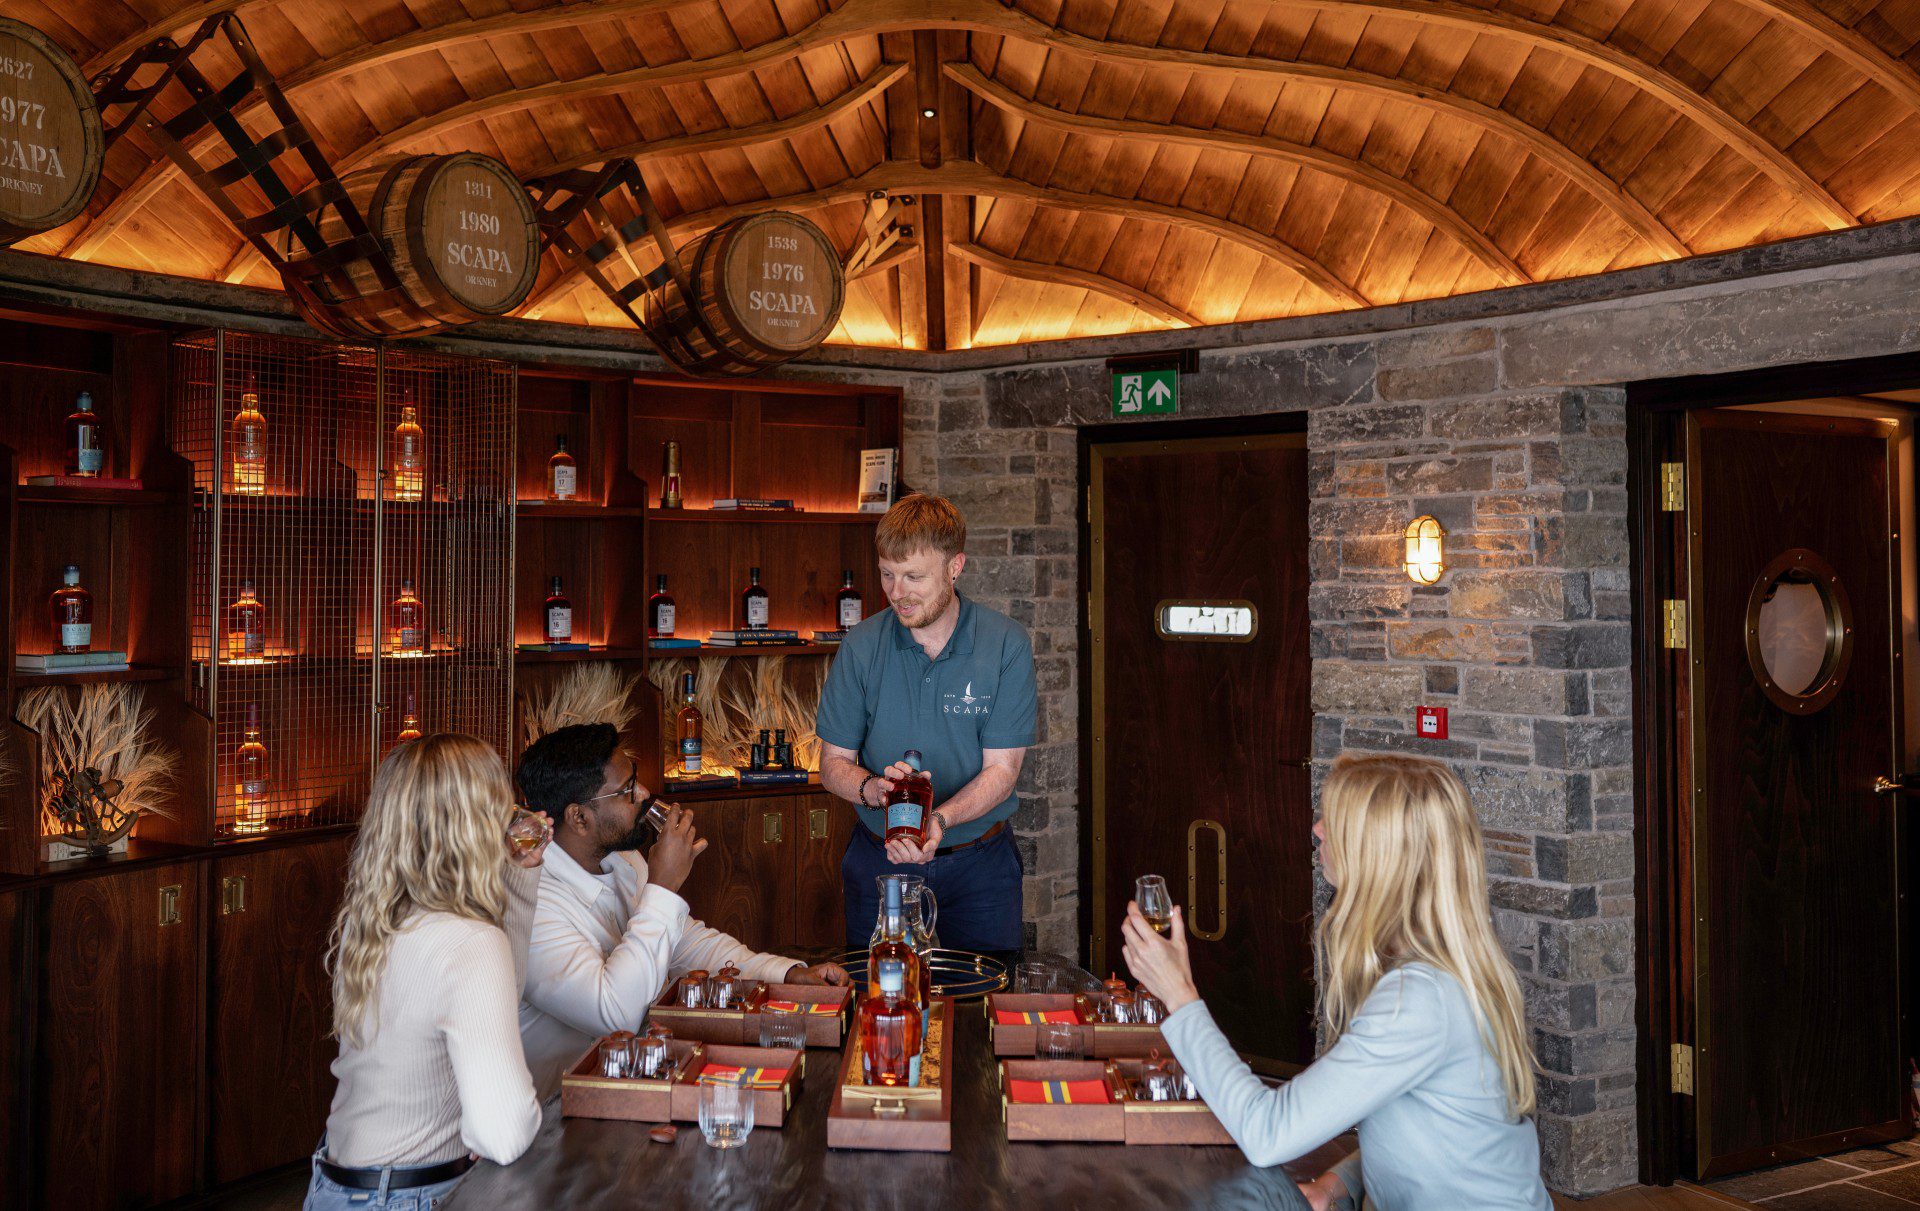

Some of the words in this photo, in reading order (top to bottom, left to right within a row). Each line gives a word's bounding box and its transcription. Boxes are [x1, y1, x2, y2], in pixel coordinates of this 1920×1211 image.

[0, 96, 46, 130] 977
[0, 136, 66, 179] CAPA
[465, 180, 493, 199] 1311
[460, 210, 500, 235] 1980
[768, 236, 797, 251] 1538
[447, 242, 512, 273] SCAPA
[465, 275, 497, 287] ORKNEY
[762, 262, 804, 282] 1976
[749, 290, 817, 315] SCAPA
[767, 317, 800, 328] ORKNEY
[943, 704, 989, 714] SCAPA
